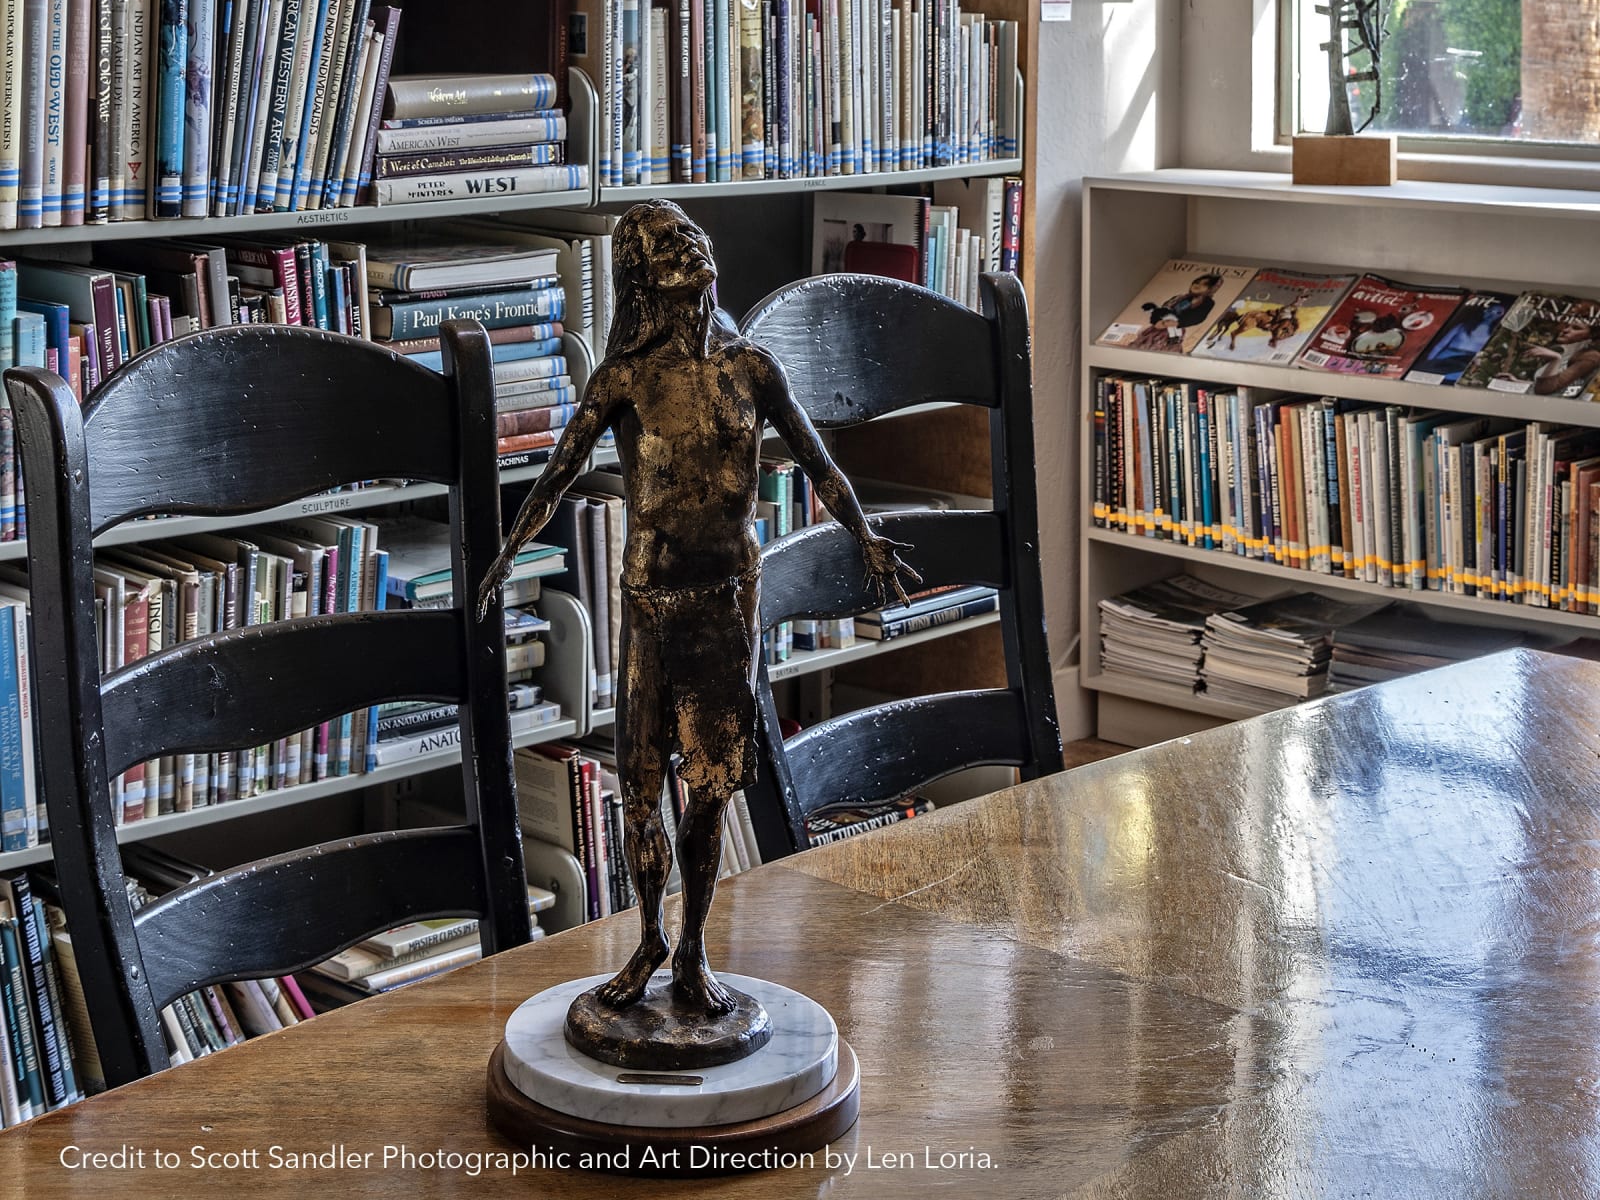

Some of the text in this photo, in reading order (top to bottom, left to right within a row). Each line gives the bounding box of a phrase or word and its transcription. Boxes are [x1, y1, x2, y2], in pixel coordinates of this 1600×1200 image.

[54, 13, 62, 26] OF
[101, 17, 112, 30] of
[134, 10, 143, 55] INDIAN
[270, 10, 279, 36] Goodrich
[323, 17, 336, 52] INDIAN
[340, 23, 350, 35] IN
[52, 28, 61, 50] THE
[100, 31, 112, 56] the
[234, 20, 244, 67] AMERICAN
[334, 37, 347, 70] THEIR
[114, 27, 124, 83] CHARLIE
[133, 59, 142, 81] ART
[264, 54, 273, 80] Winslow
[378, 20, 396, 90] THE POINT OF MY
[31, 76, 38, 86] OF
[50, 55, 62, 88] OLD
[99, 58, 112, 84] Old
[231, 71, 240, 102] INDIAN
[274, 46, 293, 114] WESTERN
[614, 58, 624, 85] Olaf
[99, 85, 111, 122] West
[114, 87, 122, 110] DYE
[133, 86, 141, 99] IN
[310, 55, 330, 136] INDIVIDUALISTS
[328, 73, 343, 109] BLOOD
[654, 35, 666, 150] FREDERIC REMINGT
[48, 91, 60, 146] WEST
[130, 102, 141, 156] AMERICA
[269, 117, 283, 148] ART
[612, 90, 624, 151] Wieghorst
[388, 136, 461, 151] AMERICAN WEST
[390, 160, 420, 172] West of
[417, 182, 445, 190] PETER
[465, 176, 518, 194] WEST
[297, 213, 349, 224] AESTHETICS
[283, 258, 299, 319] HARMSEN'S
[315, 258, 325, 300] ARIZONA
[1352, 289, 1404, 307] artist
[1465, 293, 1500, 309] art
[352, 305, 361, 332] FRITZ
[413, 308, 442, 329] Paul
[103, 327, 117, 369] WHEN THE
[495, 367, 541, 380] MERICANA
[1325, 408, 1338, 505] THE OIL PAINTING BOOK
[301, 498, 352, 513] SCULPTURE
[20, 655, 28, 692] VISUALIZING
[392, 709, 445, 728] ANATOMY FOR
[0, 706, 12, 771] HUMAN BODY
[8, 693, 20, 780] LEONARDO ON THE
[817, 811, 900, 846] DICTIONARY OF
[409, 924, 471, 951] MASTER CLASS IN
[21, 892, 66, 1102] THE PORTRAIT AND FIGURE PAINTING BOOK
[11, 967, 38, 1072] Painting Children Oil
[46, 962, 58, 1001] DRAWING
[62, 1048, 70, 1071] HEAD
